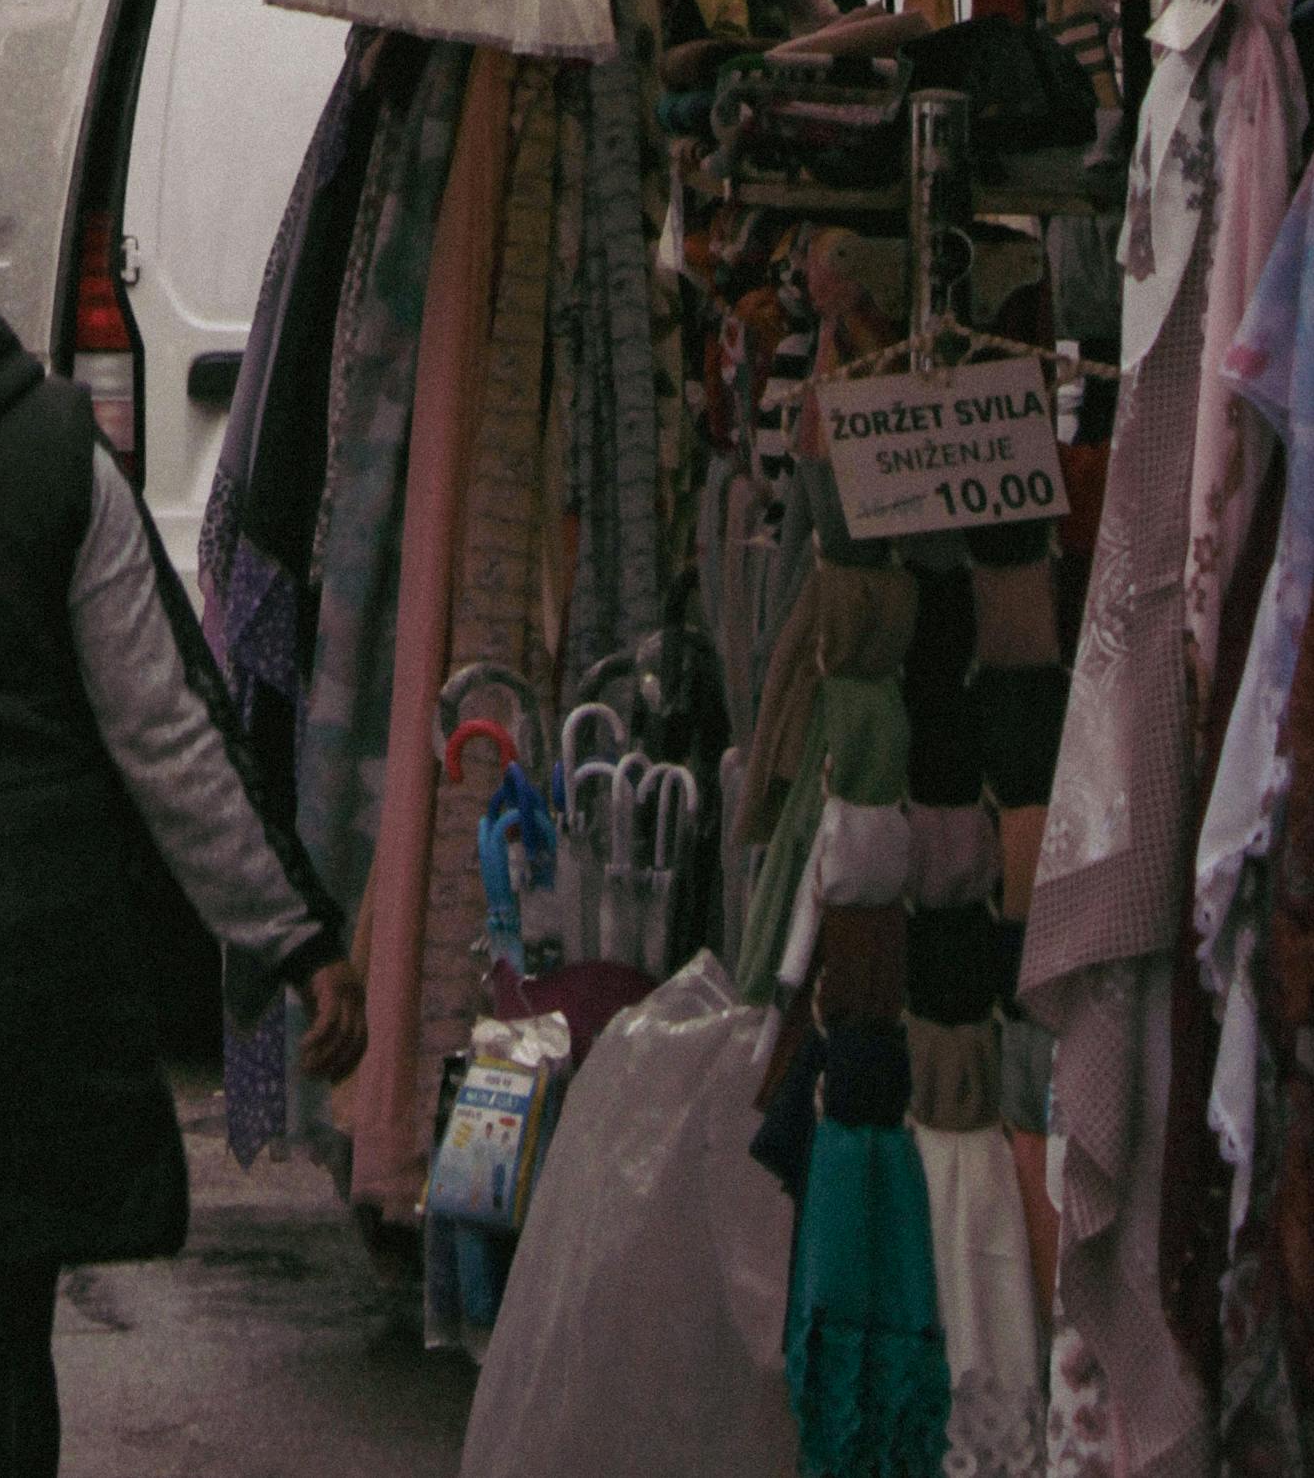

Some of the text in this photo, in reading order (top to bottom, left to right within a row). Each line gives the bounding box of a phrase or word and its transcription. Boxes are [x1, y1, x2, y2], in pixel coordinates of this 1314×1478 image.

[829, 390, 1046, 441] ŽORŽET SVILA
[875, 436, 1016, 475] SNIŽENJE
[935, 468, 1055, 517] 10,00
